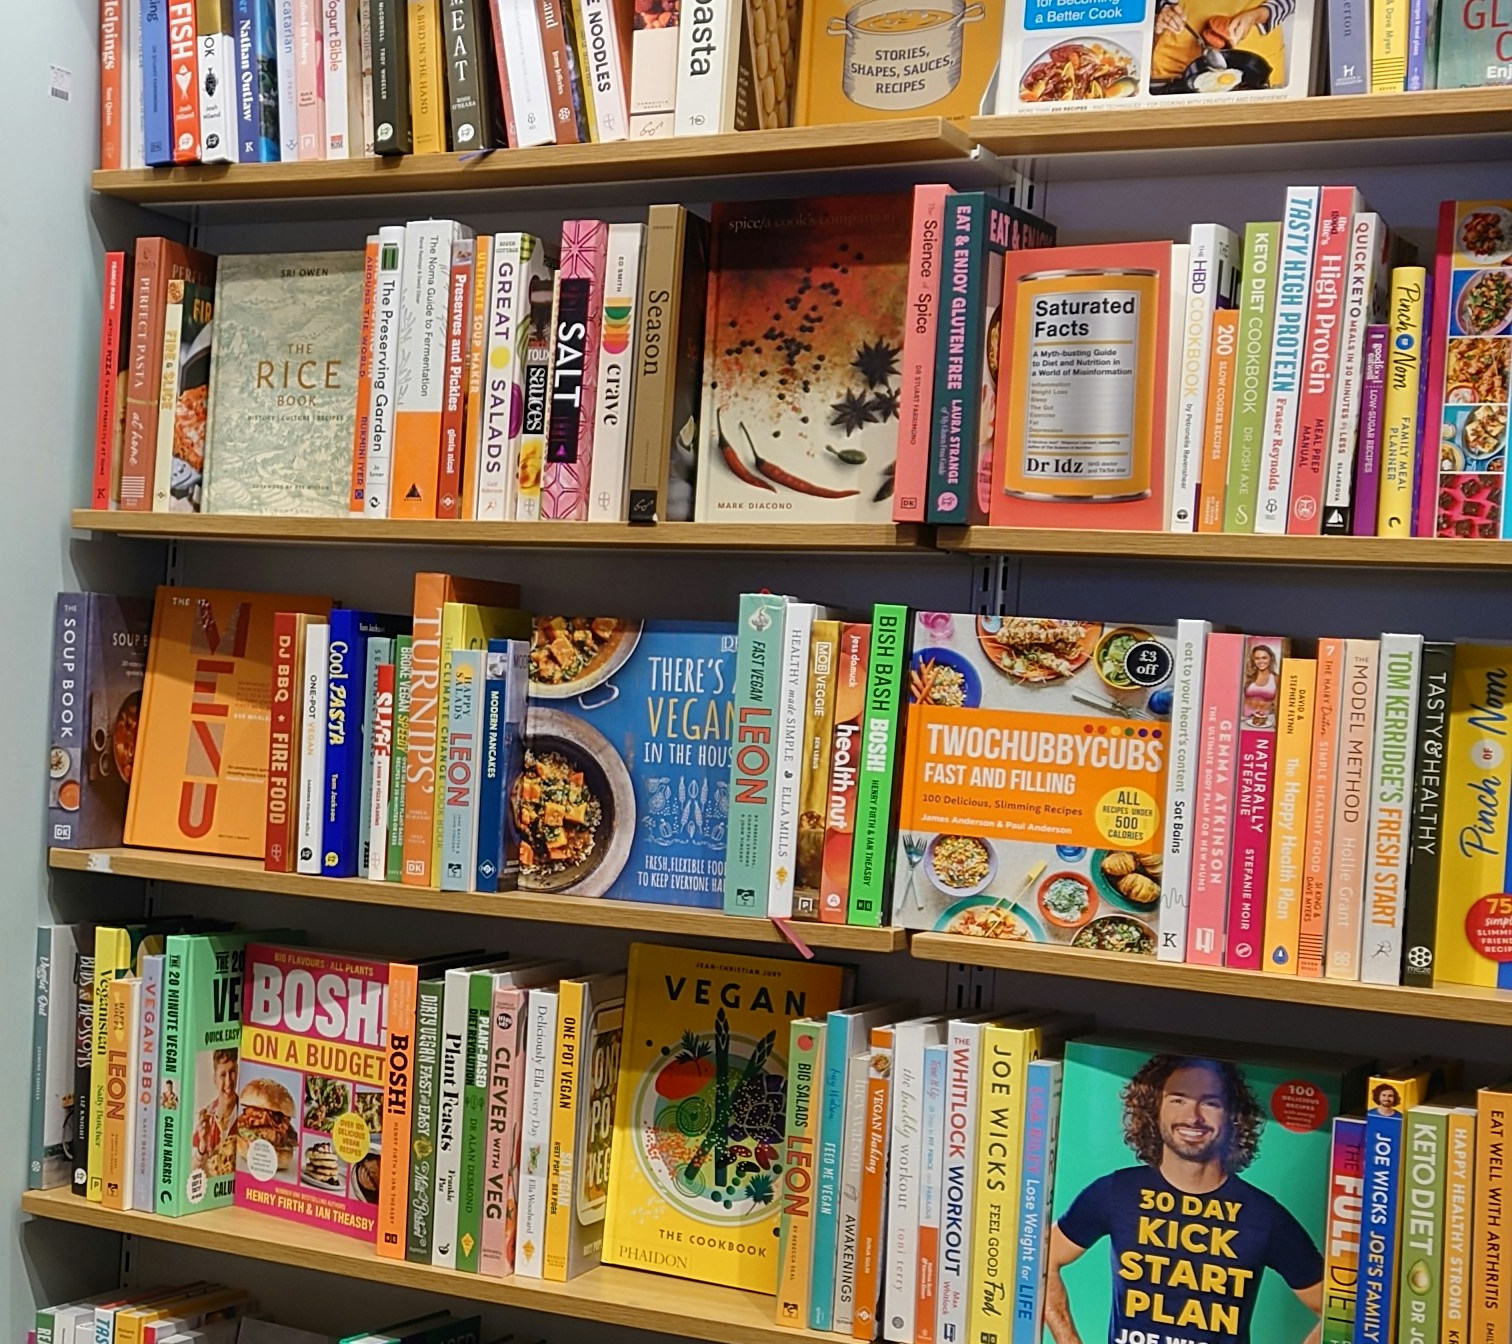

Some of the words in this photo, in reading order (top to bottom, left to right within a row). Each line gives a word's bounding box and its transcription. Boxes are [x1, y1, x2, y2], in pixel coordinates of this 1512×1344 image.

[169, 2, 193, 60] FISH
[1047, 8, 1085, 23] Better
[1088, 6, 1123, 21] Cook
[850, 62, 900, 78] SHAPES,
[903, 55, 954, 74] SAUCES,
[875, 46, 930, 60] STORIES,
[875, 79, 926, 94] RECIPES
[496, 261, 514, 342] GREAT
[1035, 296, 1135, 318] Saturated
[288, 344, 313, 354] THE
[645, 291, 670, 377] Season
[1035, 318, 1089, 339] Facts
[257, 360, 342, 389] RICE
[557, 321, 584, 407] SALT
[277, 395, 317, 408] BOOK
[487, 380, 506, 474] SALADS
[1027, 458, 1048, 474] Dr
[1051, 456, 1084, 474] Idz
[61, 618, 76, 671] SOUP
[878, 616, 897, 659] BISH
[1140, 649, 1157, 664] £3
[872, 664, 892, 711] BASH
[1136, 663, 1159, 677] off
[60, 680, 73, 738] BOOK
[736, 707, 771, 805] LEON
[867, 718, 889, 772] BOSH!
[927, 723, 1163, 773] TWOCHUBBYCUBS
[924, 762, 964, 783] FAST
[970, 766, 1005, 788] AND
[1010, 769, 1076, 795] FILLING
[664, 975, 807, 1017] VEGAN
[253, 1033, 279, 1059] ON
[285, 1040, 299, 1062] A
[307, 1043, 387, 1082] BUDGET
[388, 1033, 409, 1116] BOSH!
[783, 1136, 809, 1217] LEON
[1140, 1189, 1173, 1210] 30
[1181, 1196, 1242, 1222] DAY
[658, 1229, 682, 1243] THE
[689, 1234, 766, 1258] COOKBOOK
[1137, 1216, 1239, 1258] KICK
[1119, 1253, 1253, 1298] START
[1125, 1289, 1239, 1335] PLAN
